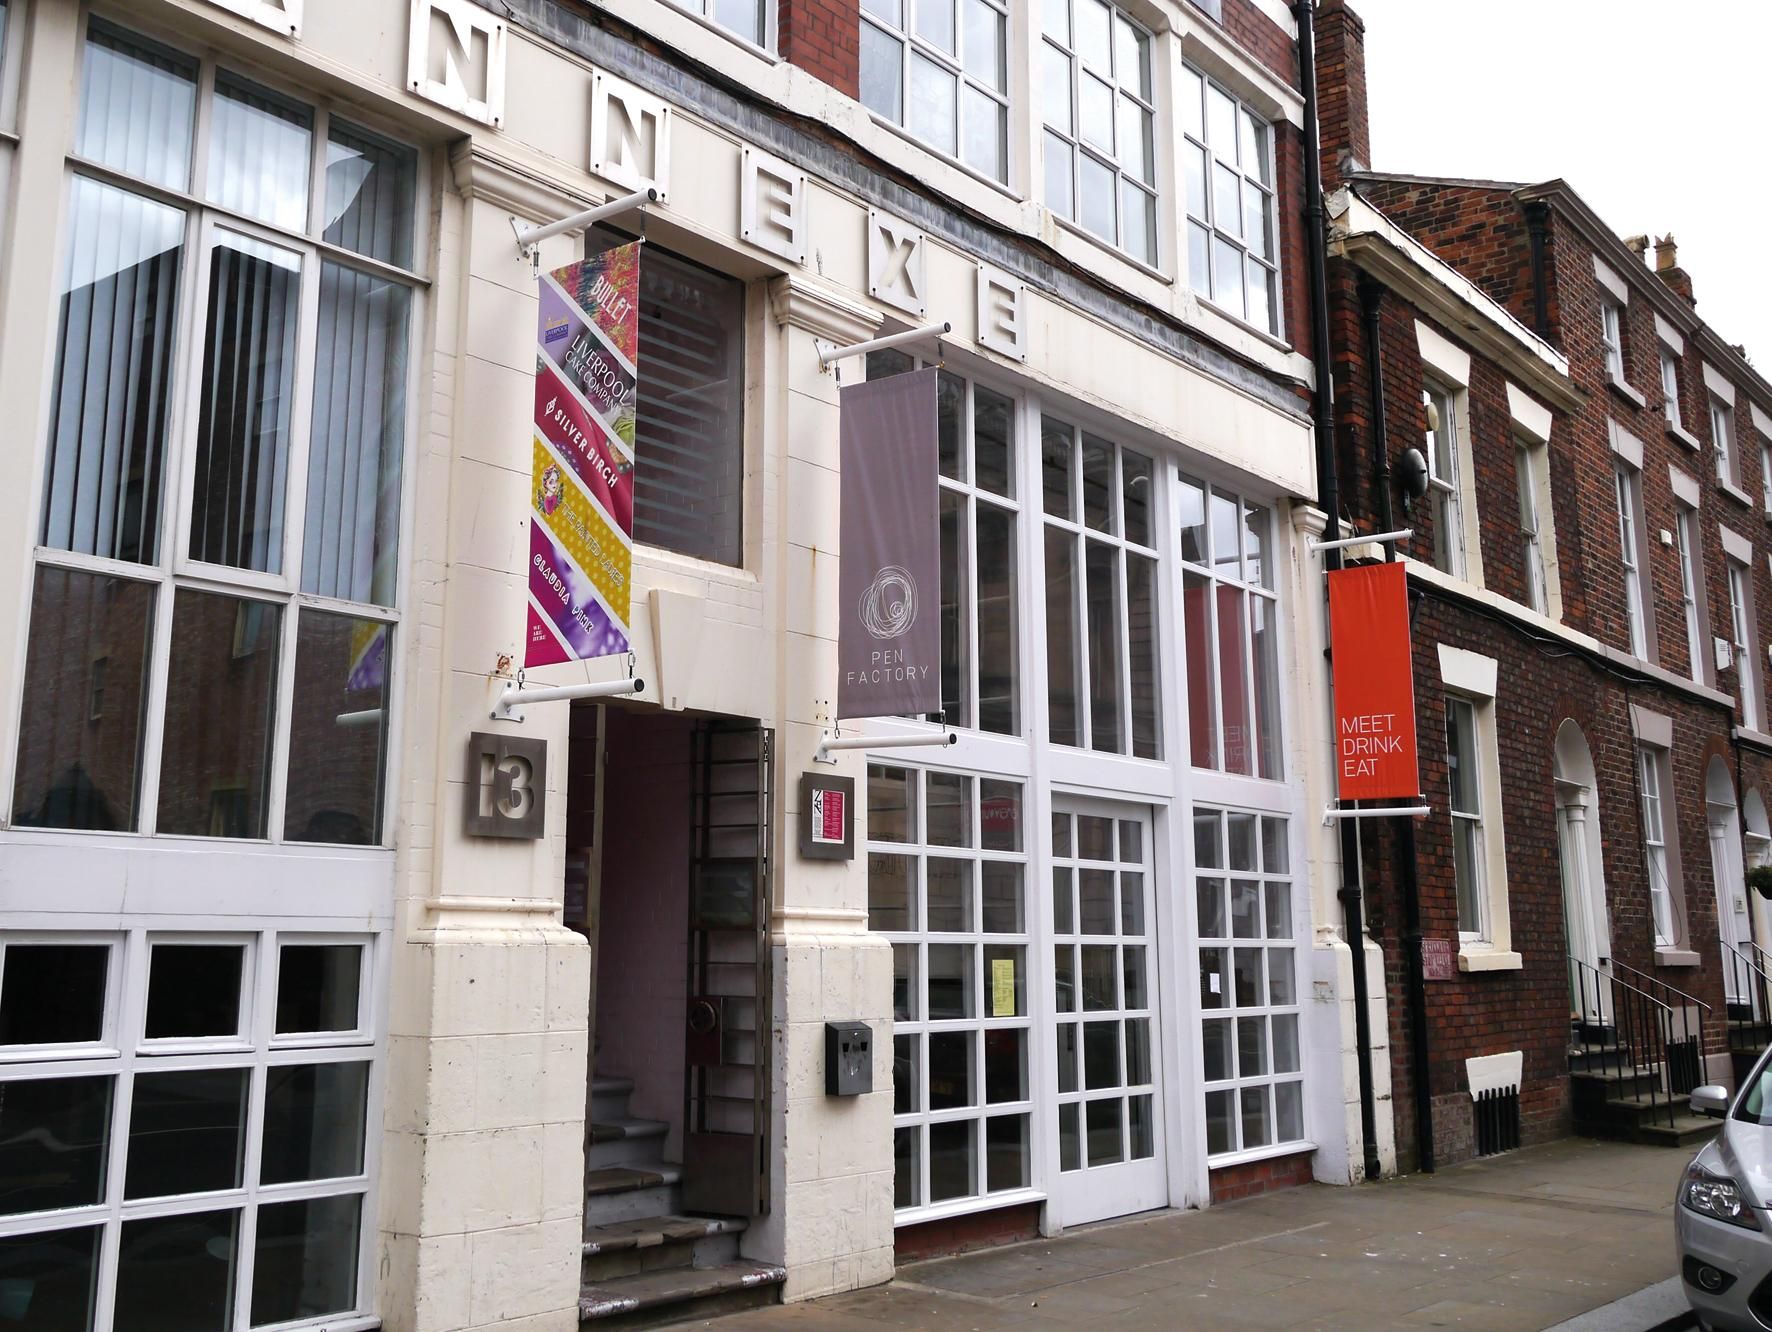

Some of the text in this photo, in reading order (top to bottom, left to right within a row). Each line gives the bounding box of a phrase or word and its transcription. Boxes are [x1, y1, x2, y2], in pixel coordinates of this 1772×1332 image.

[205, 0, 1028, 363] NNEXE
[591, 274, 632, 324] BULLET
[565, 350, 586, 376] CAKE
[571, 335, 631, 406] LIVERPOOL
[554, 409, 618, 488] SILVER BIRCH
[533, 553, 594, 634] CLAUDIA PINK
[847, 666, 929, 686] FACTORY
[871, 649, 903, 665] PEN
[1341, 713, 1396, 735] MEET
[1342, 735, 1403, 756] DRINK
[478, 752, 535, 819] 13
[1344, 758, 1379, 777] EAT
